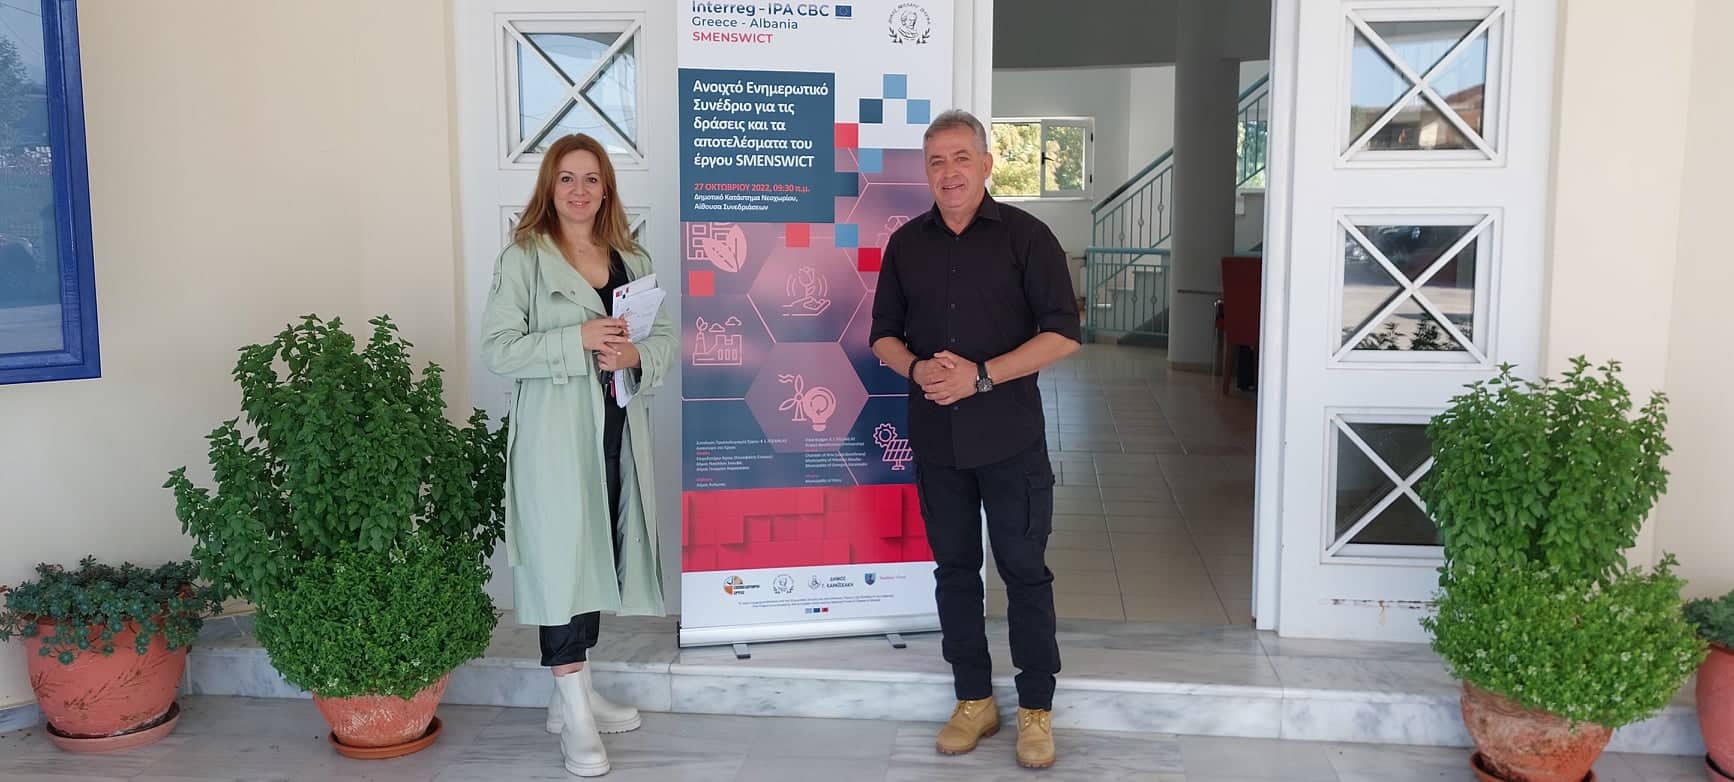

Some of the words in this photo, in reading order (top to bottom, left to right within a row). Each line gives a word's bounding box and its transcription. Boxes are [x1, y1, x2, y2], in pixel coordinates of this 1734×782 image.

[692, 1, 756, 16] Interreg
[768, 4, 793, 16] IPA
[797, 5, 830, 17] CBC
[692, 16, 738, 28] Greece
[750, 18, 798, 30] Albania
[692, 31, 773, 43] SMENSWICT
[693, 80, 743, 95] Ανοιχτό
[747, 82, 828, 96] Ενημερωτικό
[693, 99, 752, 114] Συνέδριο
[755, 102, 775, 115] για
[778, 103, 795, 115] τις
[693, 116, 745, 132] δράσεις
[748, 121, 768, 131] και
[770, 123, 786, 131] τα
[693, 135, 788, 151] αποτελέσματα
[791, 140, 812, 149] του
[693, 153, 733, 169] έργου
[736, 154, 815, 167] SMENSWICT
[694, 183, 703, 191] 27
[752, 184, 772, 193] 2022,
[773, 184, 795, 192] 09:30
[694, 193, 724, 202] Δημοτικό
[725, 194, 760, 203] Κατάστημα
[694, 202, 722, 211] Αίθουσα
[723, 203, 769, 213] Συνεδριάσεων
